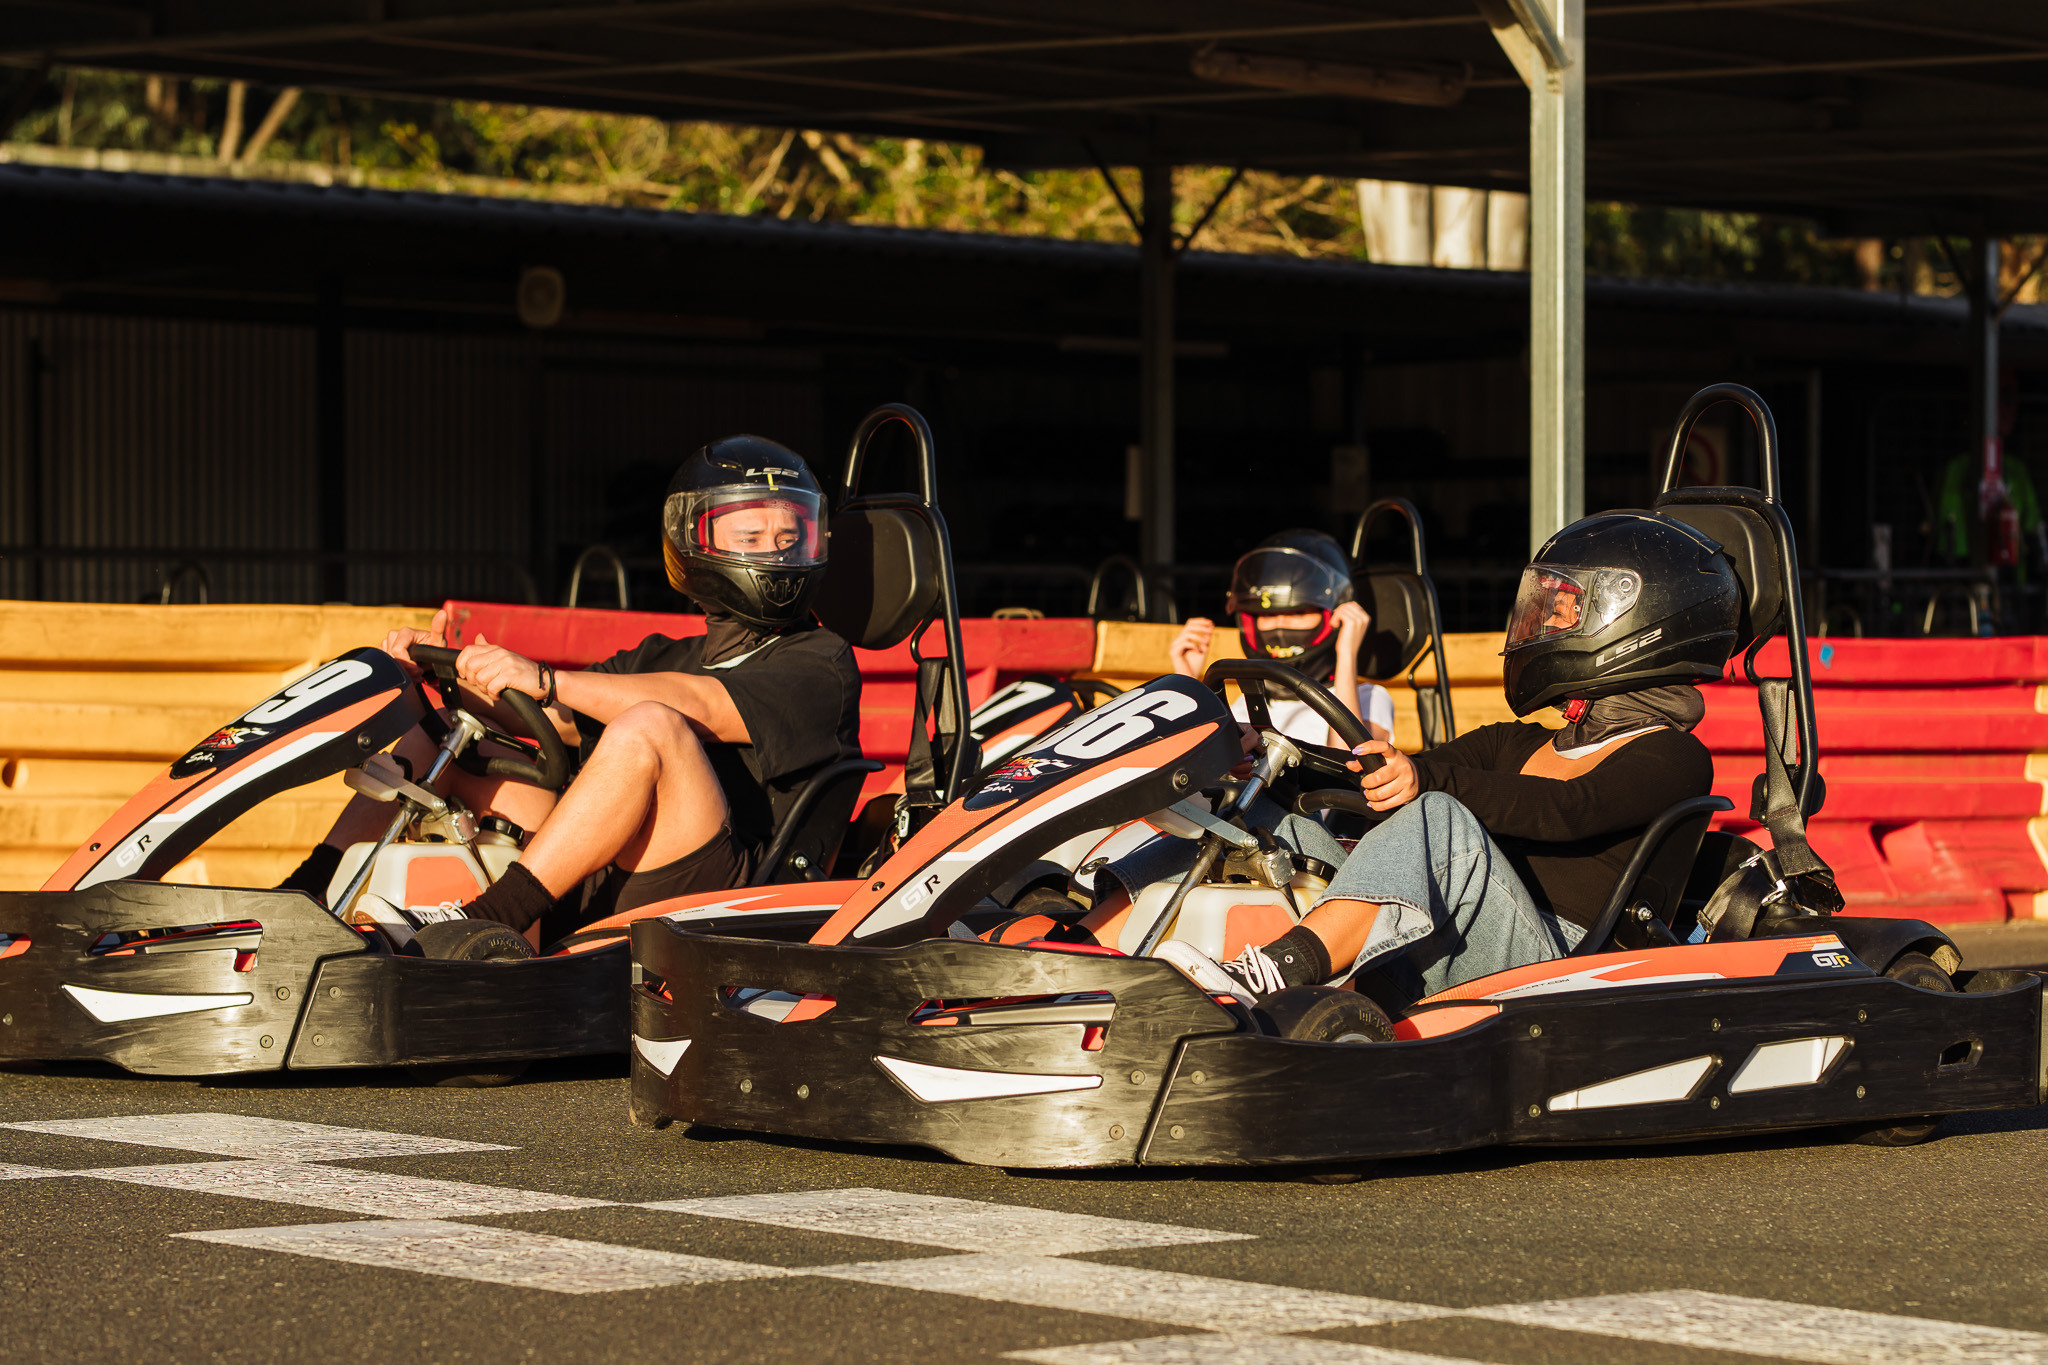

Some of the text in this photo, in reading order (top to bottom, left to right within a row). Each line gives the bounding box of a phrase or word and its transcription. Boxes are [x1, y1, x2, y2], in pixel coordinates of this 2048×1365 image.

[746, 467, 800, 479] LS2
[1595, 627, 1662, 668] LS2
[225, 658, 374, 726] 9
[115, 834, 152, 868] GTR
[900, 874, 941, 911] GTR
[1811, 951, 1852, 968] GTR
